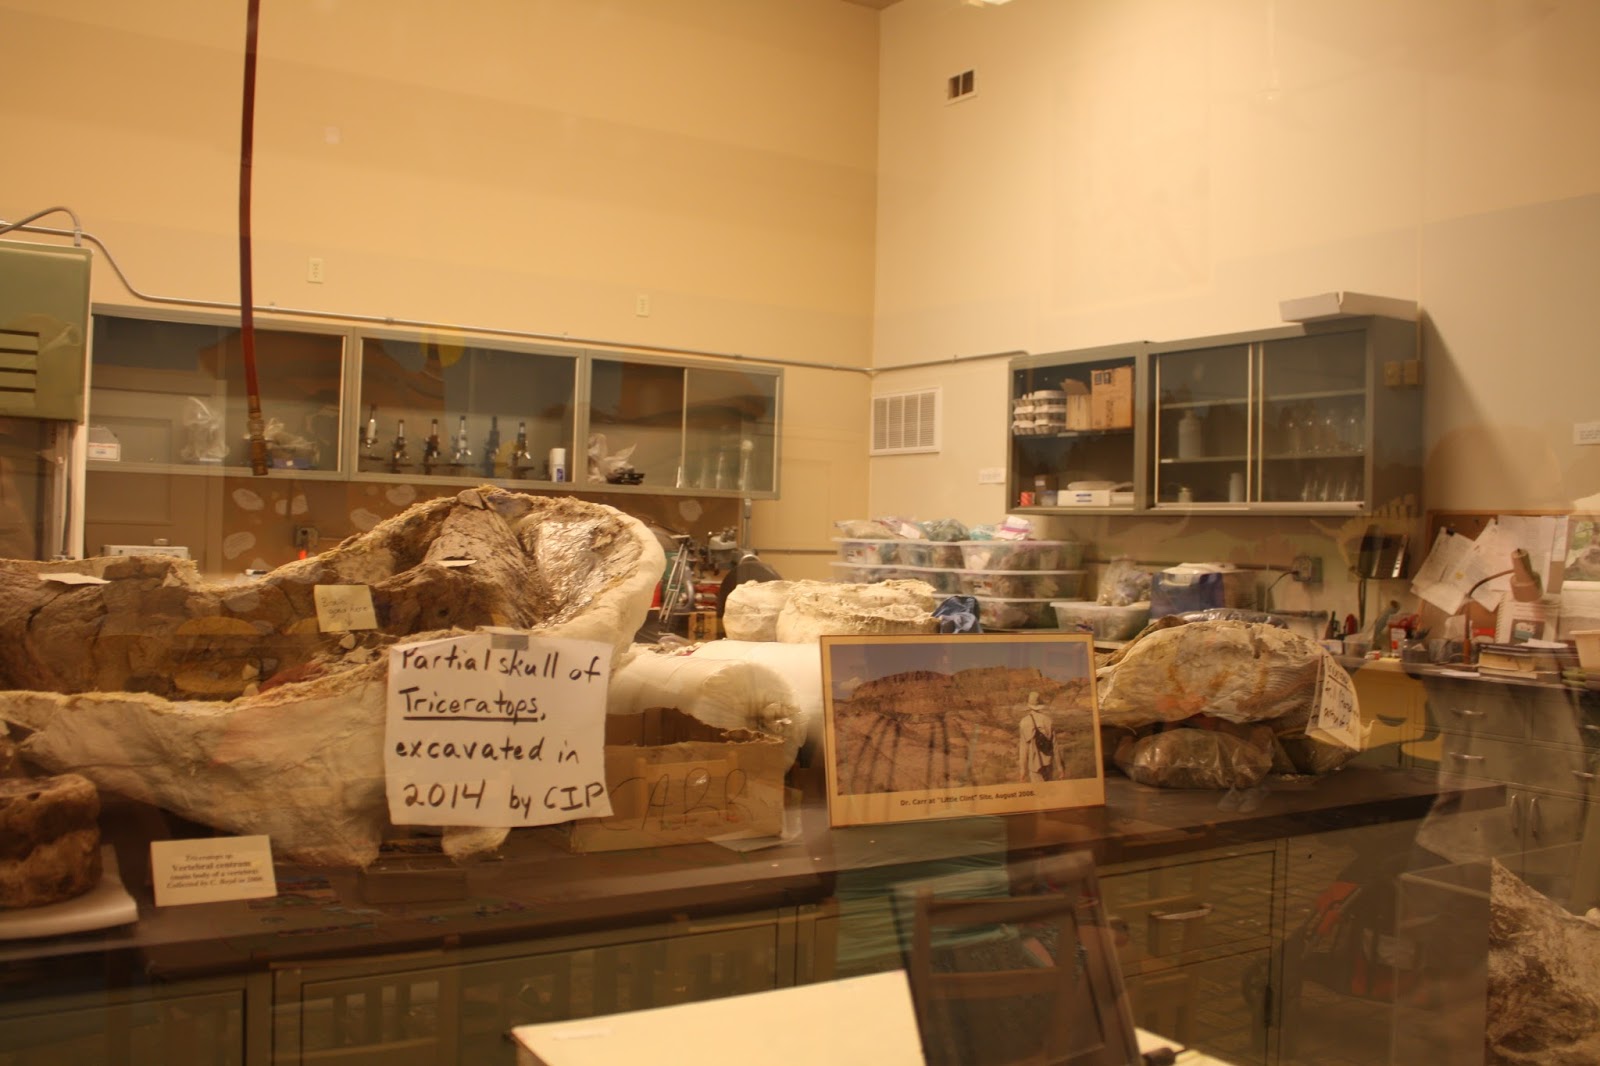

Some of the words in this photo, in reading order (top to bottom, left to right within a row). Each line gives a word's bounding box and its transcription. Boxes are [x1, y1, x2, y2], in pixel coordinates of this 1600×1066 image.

[402, 644, 490, 670] Partial
[499, 650, 559, 678] skull
[569, 656, 601, 682] of
[398, 686, 546, 725] Triceratops,
[395, 736, 545, 761] excavated
[557, 740, 580, 764] in
[403, 779, 486, 809] 2014
[509, 785, 531, 819] by
[544, 782, 604, 811] CIP
